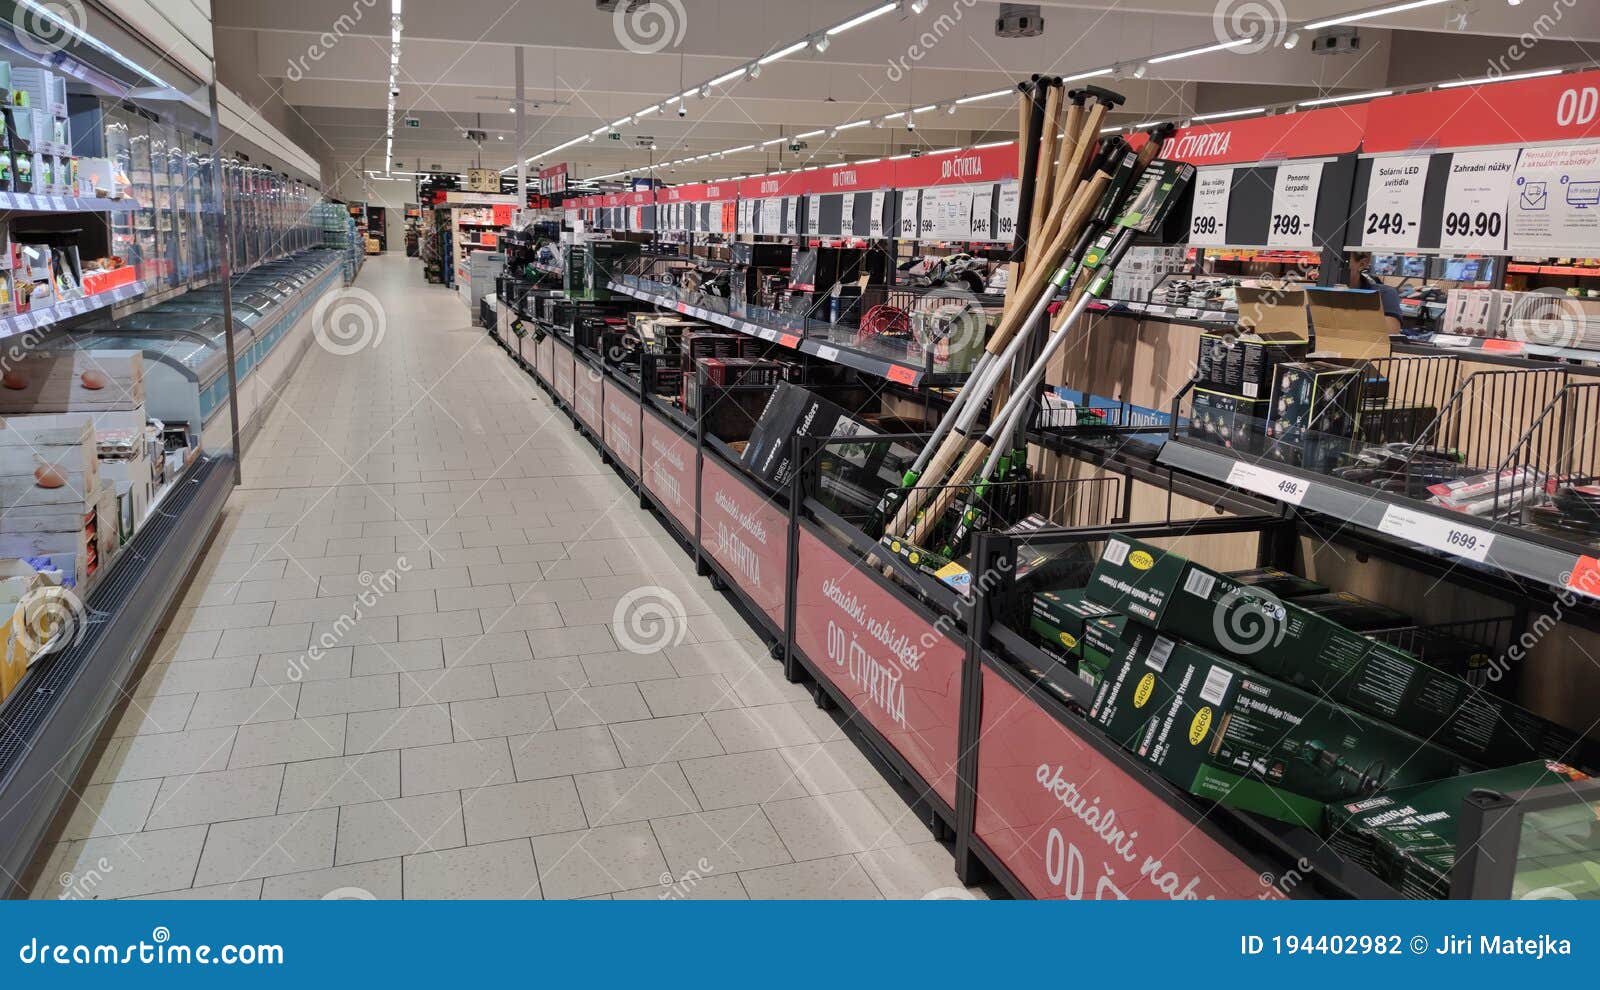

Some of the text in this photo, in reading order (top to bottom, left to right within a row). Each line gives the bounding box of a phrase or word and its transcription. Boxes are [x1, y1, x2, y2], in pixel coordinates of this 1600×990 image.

[1556, 87, 1599, 127] OD
[1175, 131, 1232, 159] ČTVRTKA
[942, 155, 982, 178] OD ČTVRTKA
[1379, 166, 1419, 176] Solární LED
[1384, 179, 1409, 187] svítidla
[1453, 162, 1511, 173] Zahradní nůžky
[1366, 212, 1417, 235] 249.-
[1445, 211, 1501, 237] 99.90
[797, 402, 819, 436] Enders
[823, 577, 920, 673] aktuální nabídka
[827, 620, 906, 729] OD ČTVRTKA
[1135, 673, 1155, 706] 340608
[1099, 680, 1122, 724] Long-Handle
[1117, 661, 1131, 683] Hedge
[1237, 693, 1269, 713] Long-Handle
[1267, 704, 1284, 719] Hedge
[1149, 715, 1175, 763] Long-Handle
[1167, 694, 1183, 718] Hedge
[1176, 663, 1196, 695] Trimmer
[1190, 707, 1211, 745] 340608
[1036, 763, 1138, 862] aktuální
[1046, 827, 1085, 900] OD
